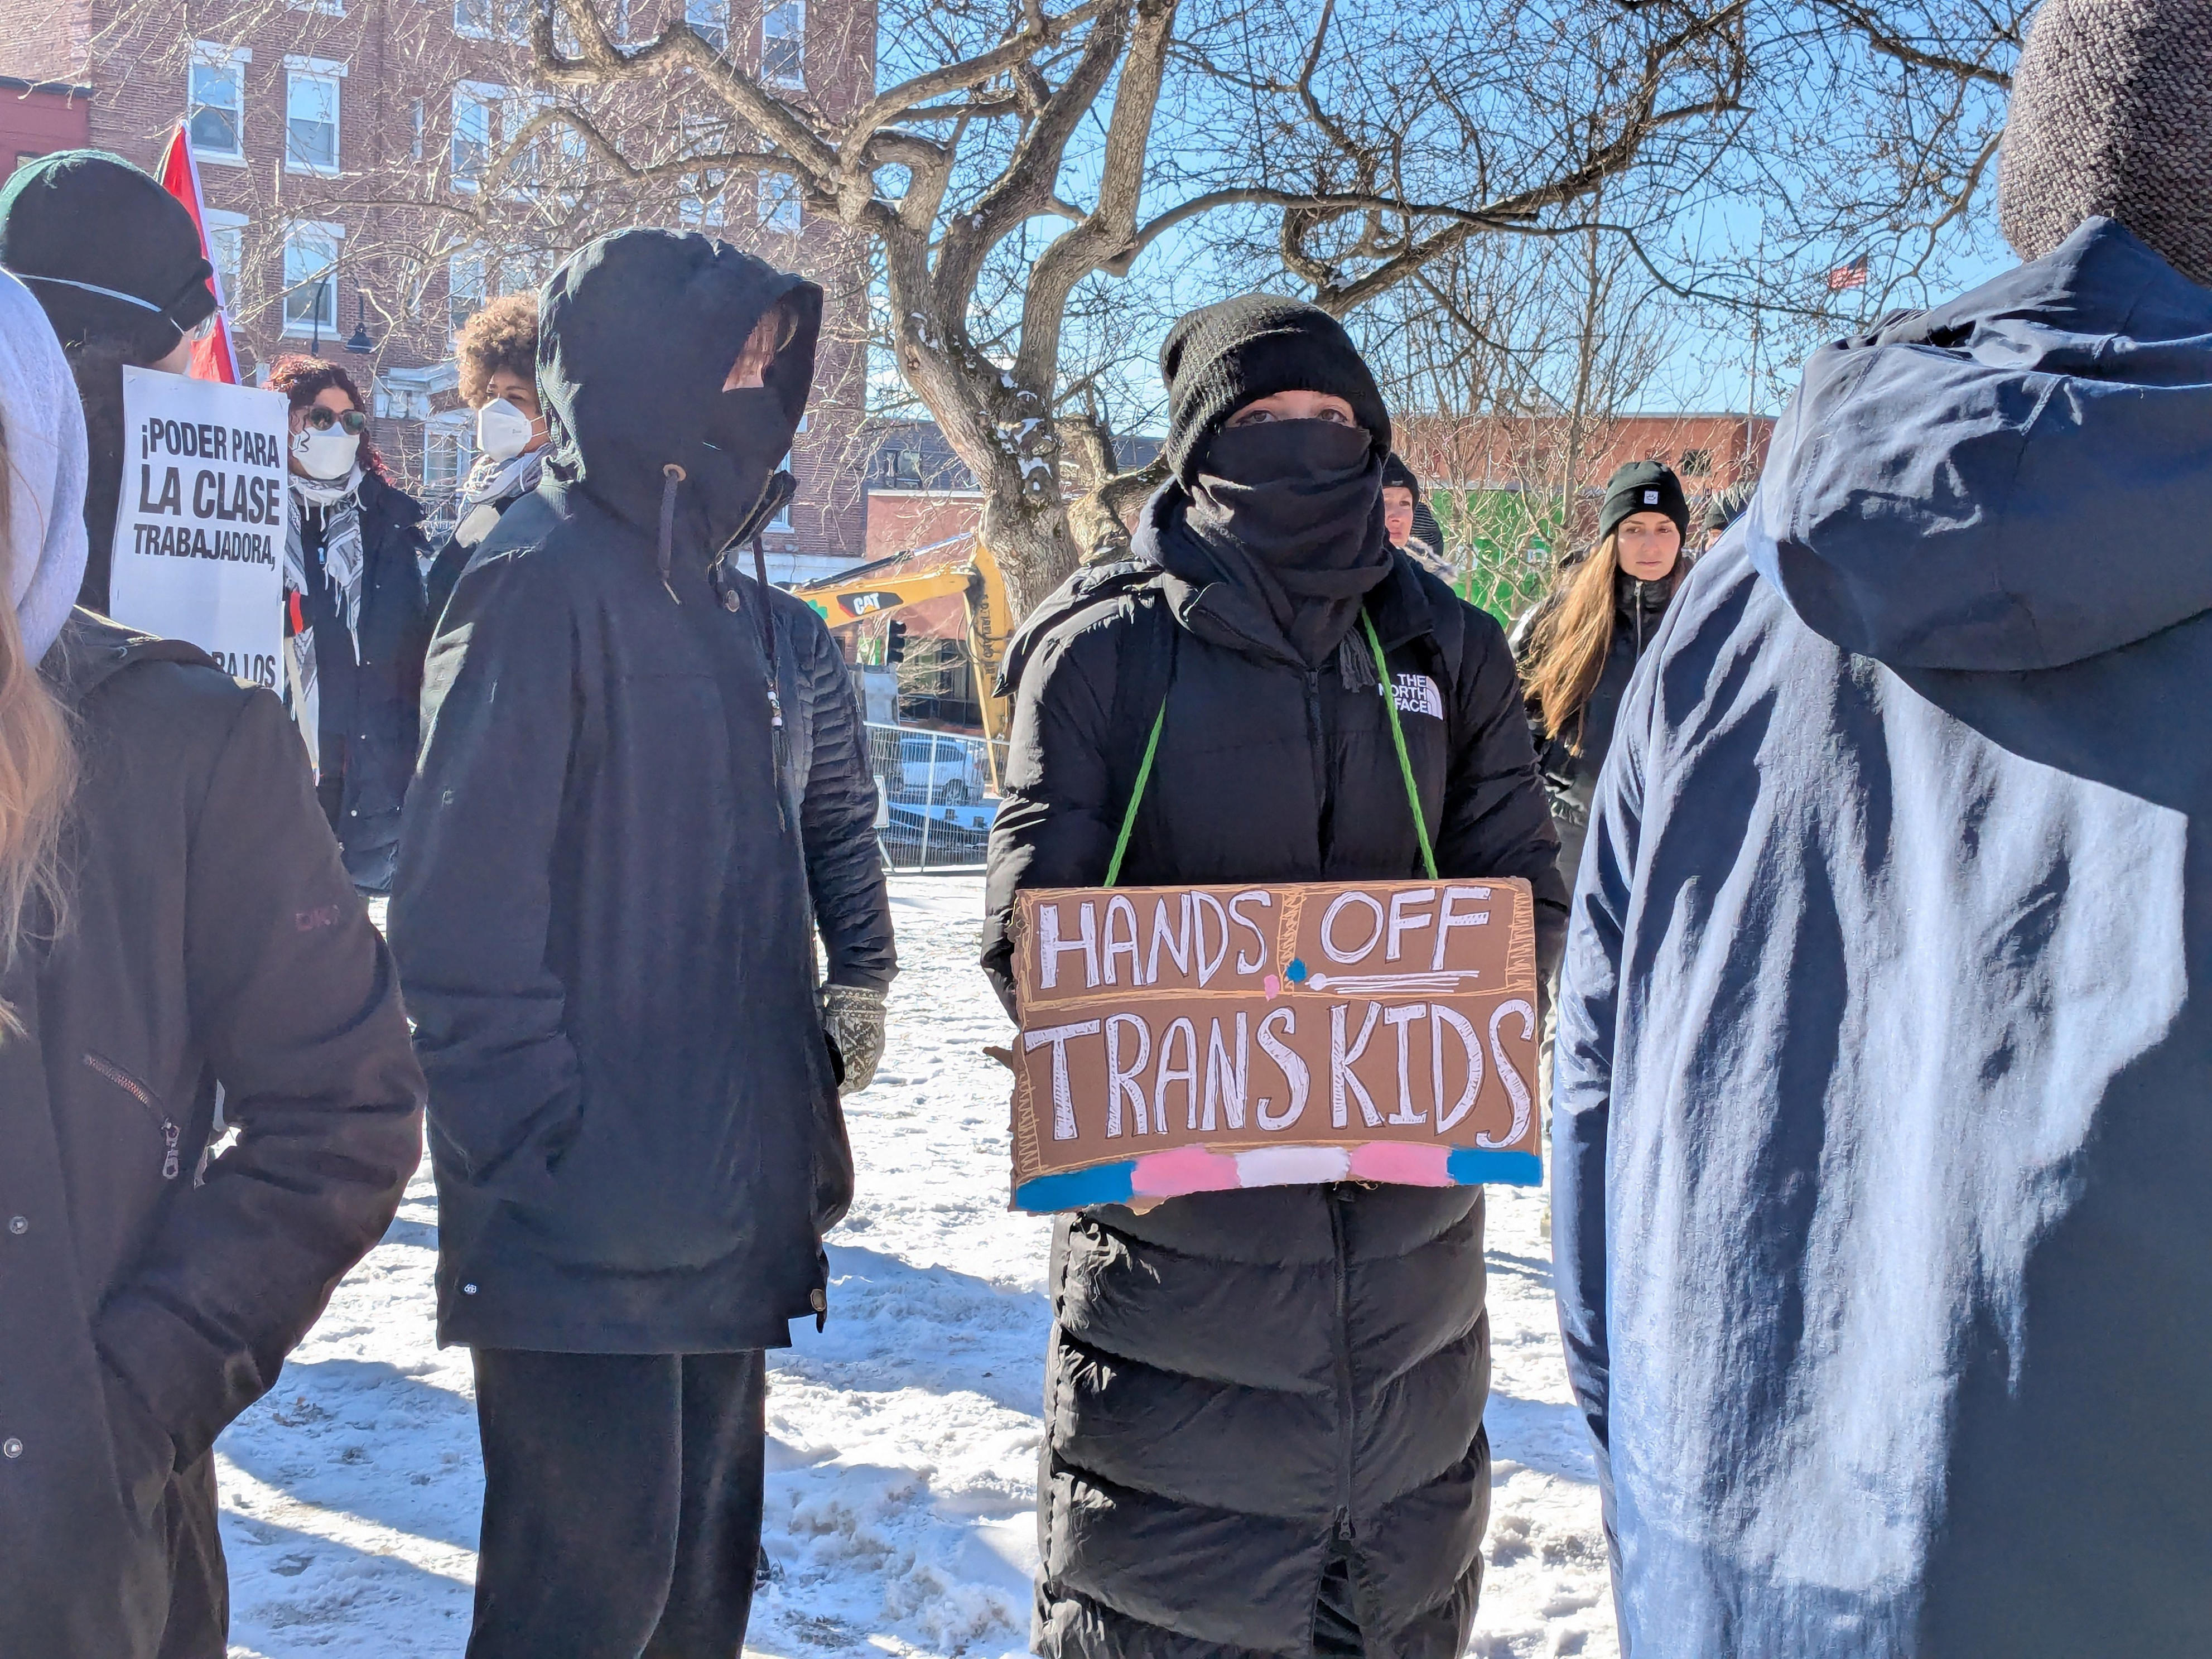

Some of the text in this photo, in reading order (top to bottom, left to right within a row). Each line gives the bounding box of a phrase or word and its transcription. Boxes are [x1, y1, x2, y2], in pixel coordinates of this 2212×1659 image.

[142, 417, 280, 469] ¡PODER PARA
[138, 464, 280, 526] LA CLASE
[133, 523, 276, 572] TRABAJADORA,
[853, 592, 880, 615] CAT
[1396, 673, 1427, 688] THE
[1394, 698, 1429, 714] FACE
[1039, 886, 1492, 990] HANDS OFF
[1024, 998, 1537, 1149] TRANS KIDS
